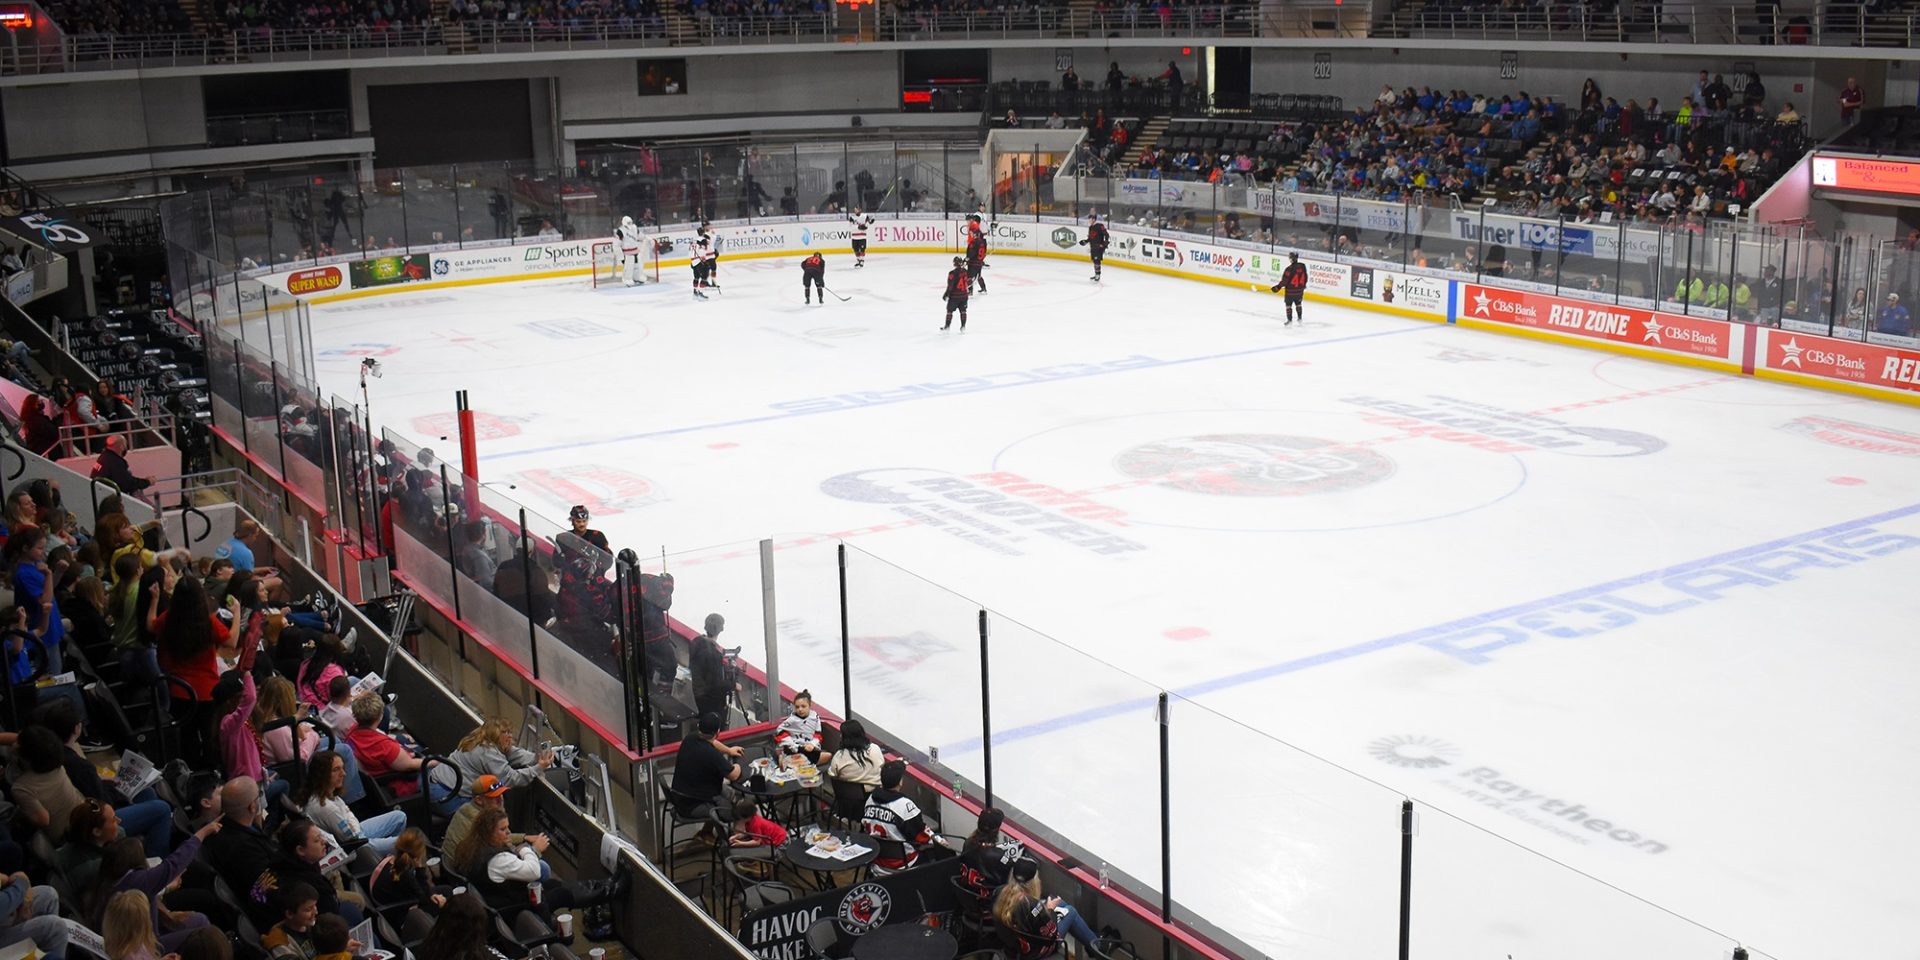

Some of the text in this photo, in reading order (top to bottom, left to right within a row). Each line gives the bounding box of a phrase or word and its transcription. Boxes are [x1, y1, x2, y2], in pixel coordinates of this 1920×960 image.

[1314, 62, 1330, 78] 202
[1501, 61, 1517, 78] 203
[1735, 73, 1750, 92] 20
[1844, 161, 1909, 174] Balanced
[892, 225, 946, 242] Mobile
[998, 226, 1027, 241] Clips
[1054, 231, 1077, 242] MELT
[1455, 216, 1515, 245] Turner
[1521, 223, 1556, 244] TOC
[726, 235, 785, 248] FREEDOM
[1141, 238, 1177, 261] CTS
[1639, 240, 1671, 254] Cener
[454, 256, 512, 267] GE APPLIANCES
[544, 244, 588, 263] Sports
[1190, 250, 1233, 267] TEAM DAKS
[290, 279, 315, 293] SUPER
[315, 275, 340, 287] WASH
[1309, 271, 1342, 281] FOUNDATION
[1492, 299, 1537, 317] CB&S Bank
[1547, 304, 1631, 337] RED ZONE
[1664, 326, 1718, 346] CB&S Bank
[1806, 349, 1866, 371] CB&S Bank
[1414, 528, 1919, 665] POLARIS
[1458, 766, 1669, 855] Raytheon
[840, 885, 890, 917] HUNTSVILLE
